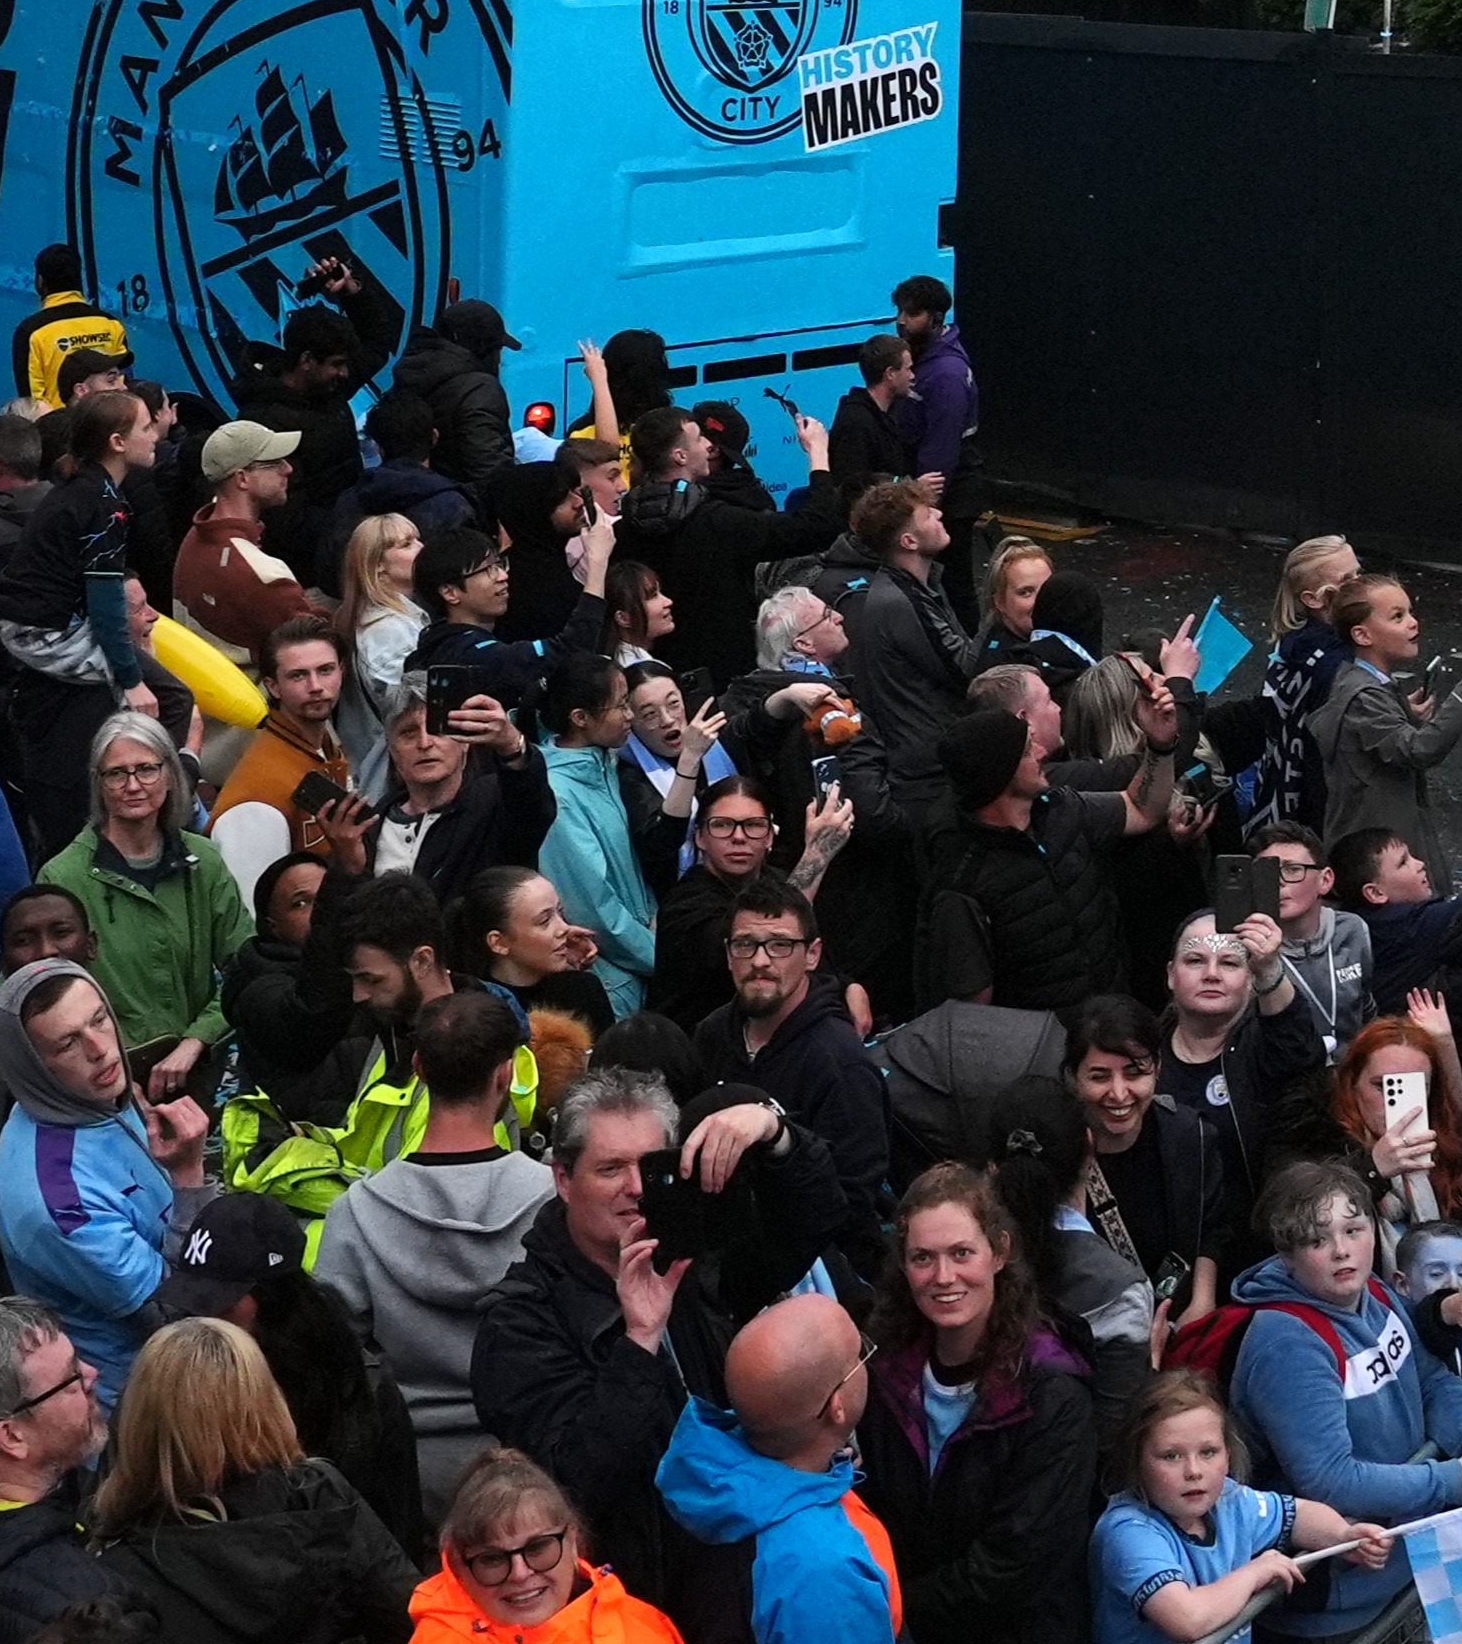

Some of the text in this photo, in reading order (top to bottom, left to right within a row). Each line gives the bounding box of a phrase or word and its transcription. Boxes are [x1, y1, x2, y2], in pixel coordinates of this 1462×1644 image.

[663, 1, 679, 14] 18
[800, 26, 935, 89] HISTORY
[721, 96, 781, 122] CITY
[804, 61, 938, 149] MAKERS
[116, 118, 501, 317] 18 94
